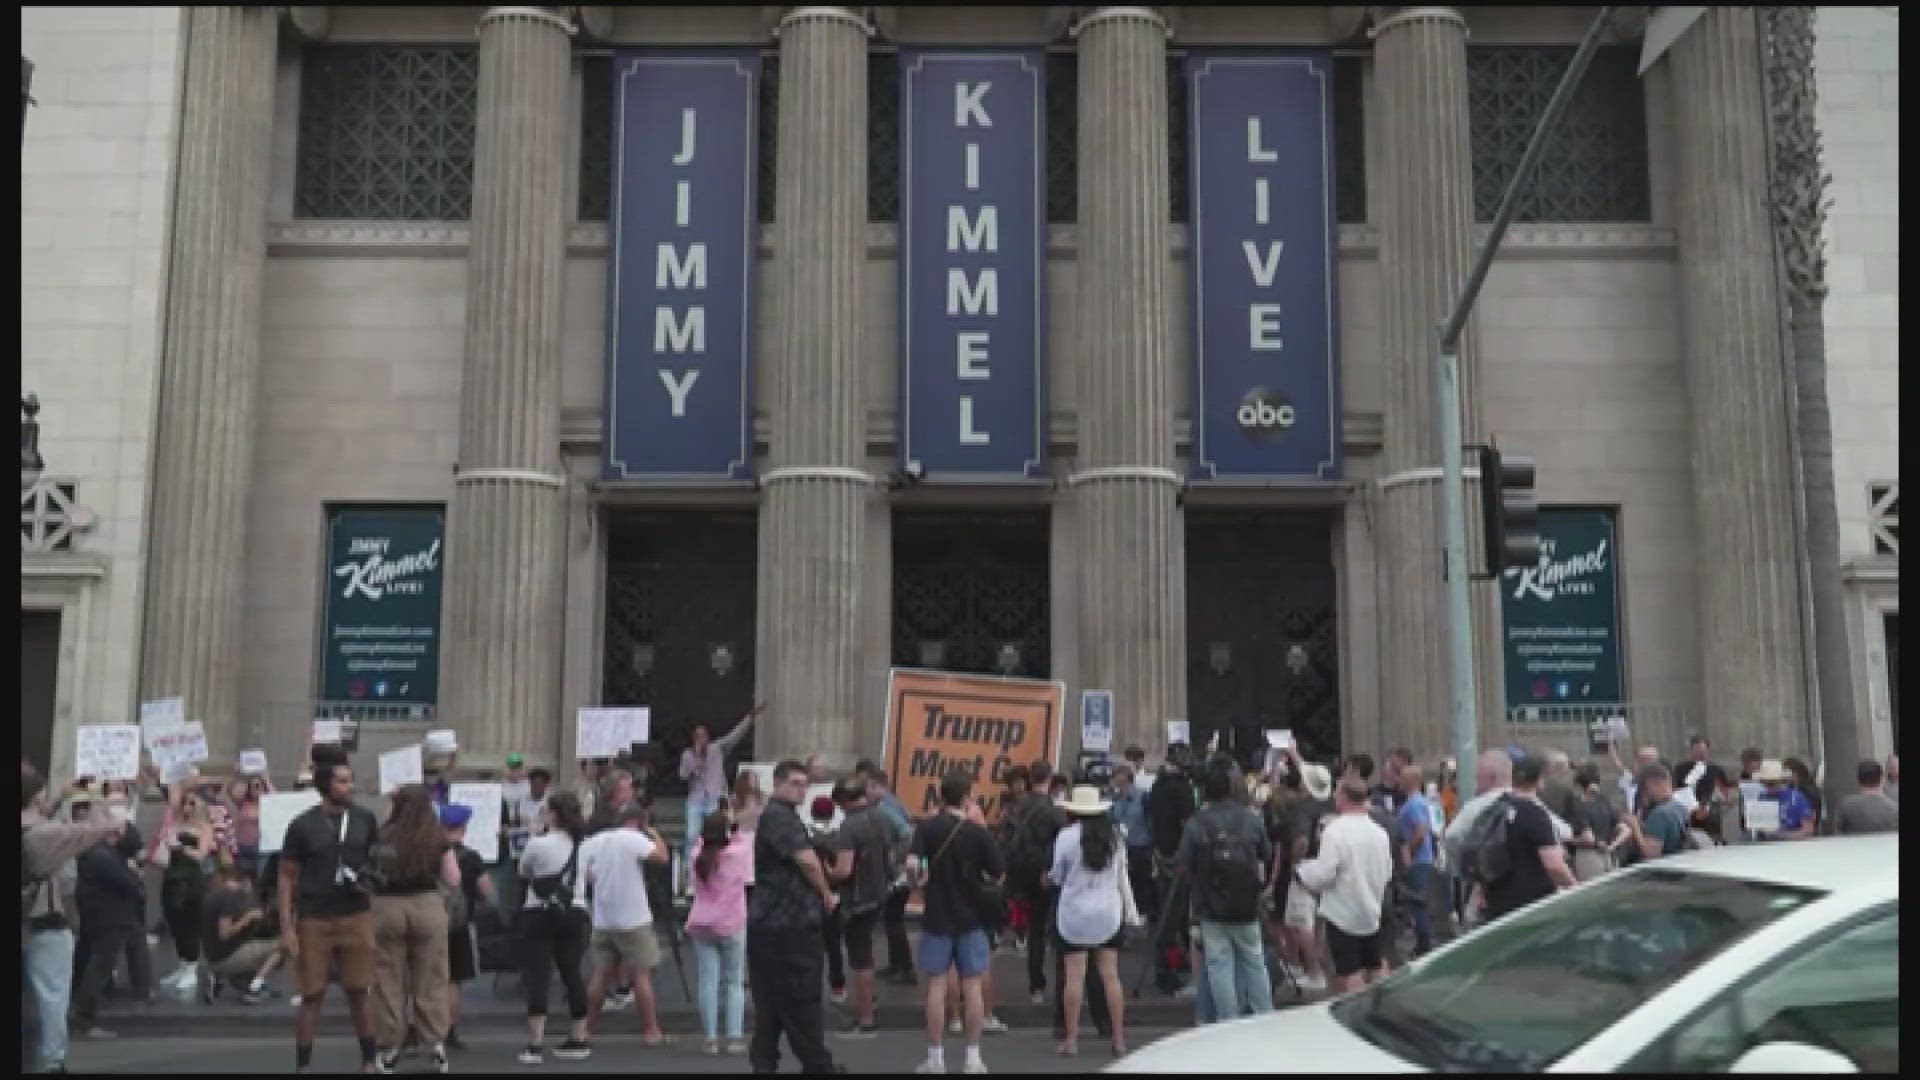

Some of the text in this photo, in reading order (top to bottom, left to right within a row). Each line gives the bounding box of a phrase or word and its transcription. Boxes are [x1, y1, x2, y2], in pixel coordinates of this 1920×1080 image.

[654, 108, 707, 417] JIMMY
[946, 82, 998, 444] KIMMEL
[1242, 117, 1284, 350] LIVE
[1236, 398, 1294, 427] abc
[335, 537, 441, 599] Kimmel
[923, 703, 1025, 753] Trump
